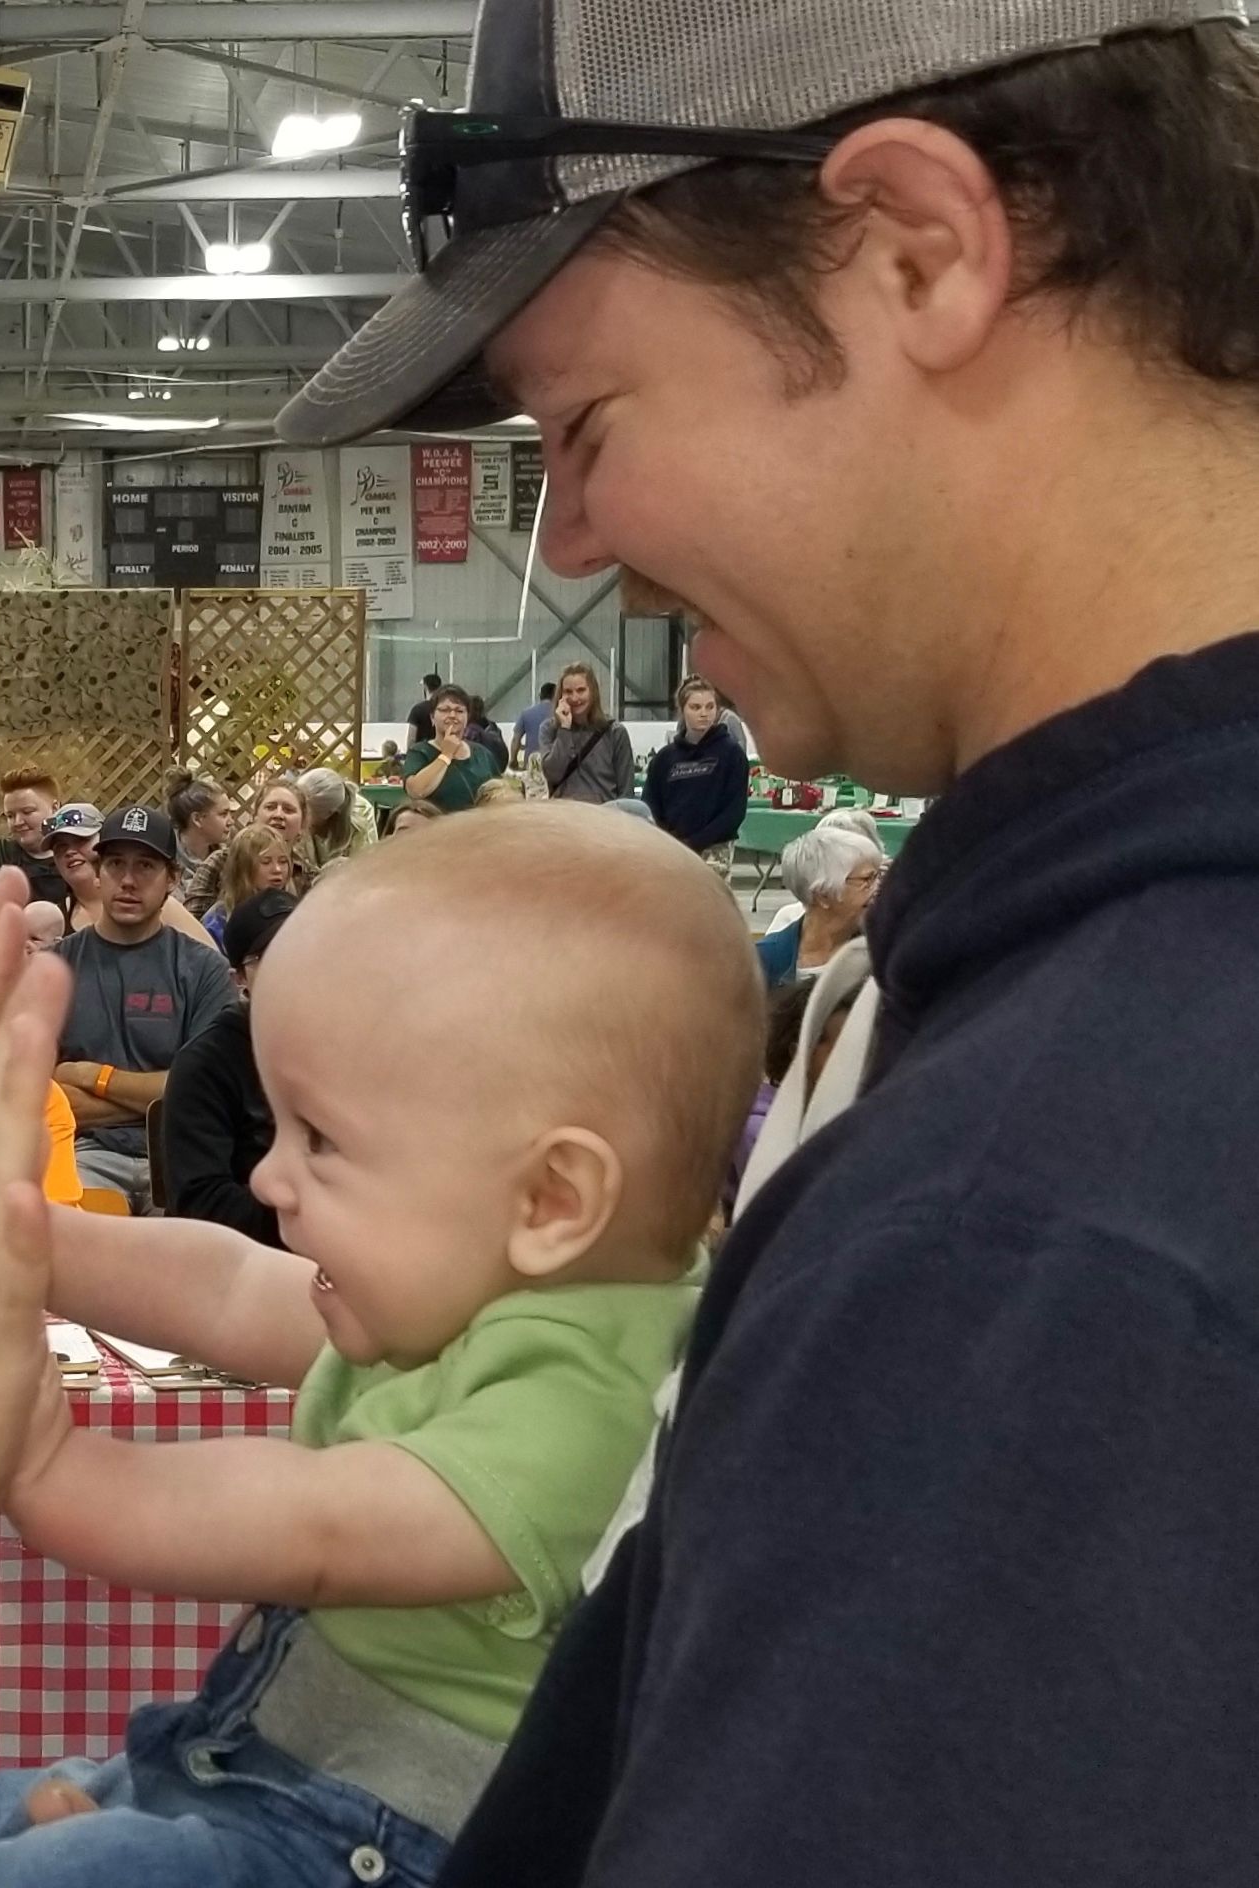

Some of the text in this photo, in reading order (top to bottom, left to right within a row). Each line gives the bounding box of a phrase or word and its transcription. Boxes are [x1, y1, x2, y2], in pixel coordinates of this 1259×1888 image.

[423, 459, 461, 468] PEEWEE
[415, 476, 468, 486] CHAMPIONS
[112, 493, 149, 503] HOME
[222, 492, 259, 502] VISITOR
[278, 504, 311, 513] BANTAM
[360, 506, 390, 515] PEE WEE
[291, 518, 298, 528] C
[373, 517, 378, 525] C
[355, 527, 396, 536] CHAMPIONS
[274, 532, 315, 541] FINALISTS
[171, 544, 200, 553] PERIOD
[417, 540, 467, 549] 2002 2003
[268, 546, 290, 555] 2004
[299, 544, 322, 555] 2005
[115, 565, 150, 574] PENALTY
[220, 564, 255, 573] PENALTY
